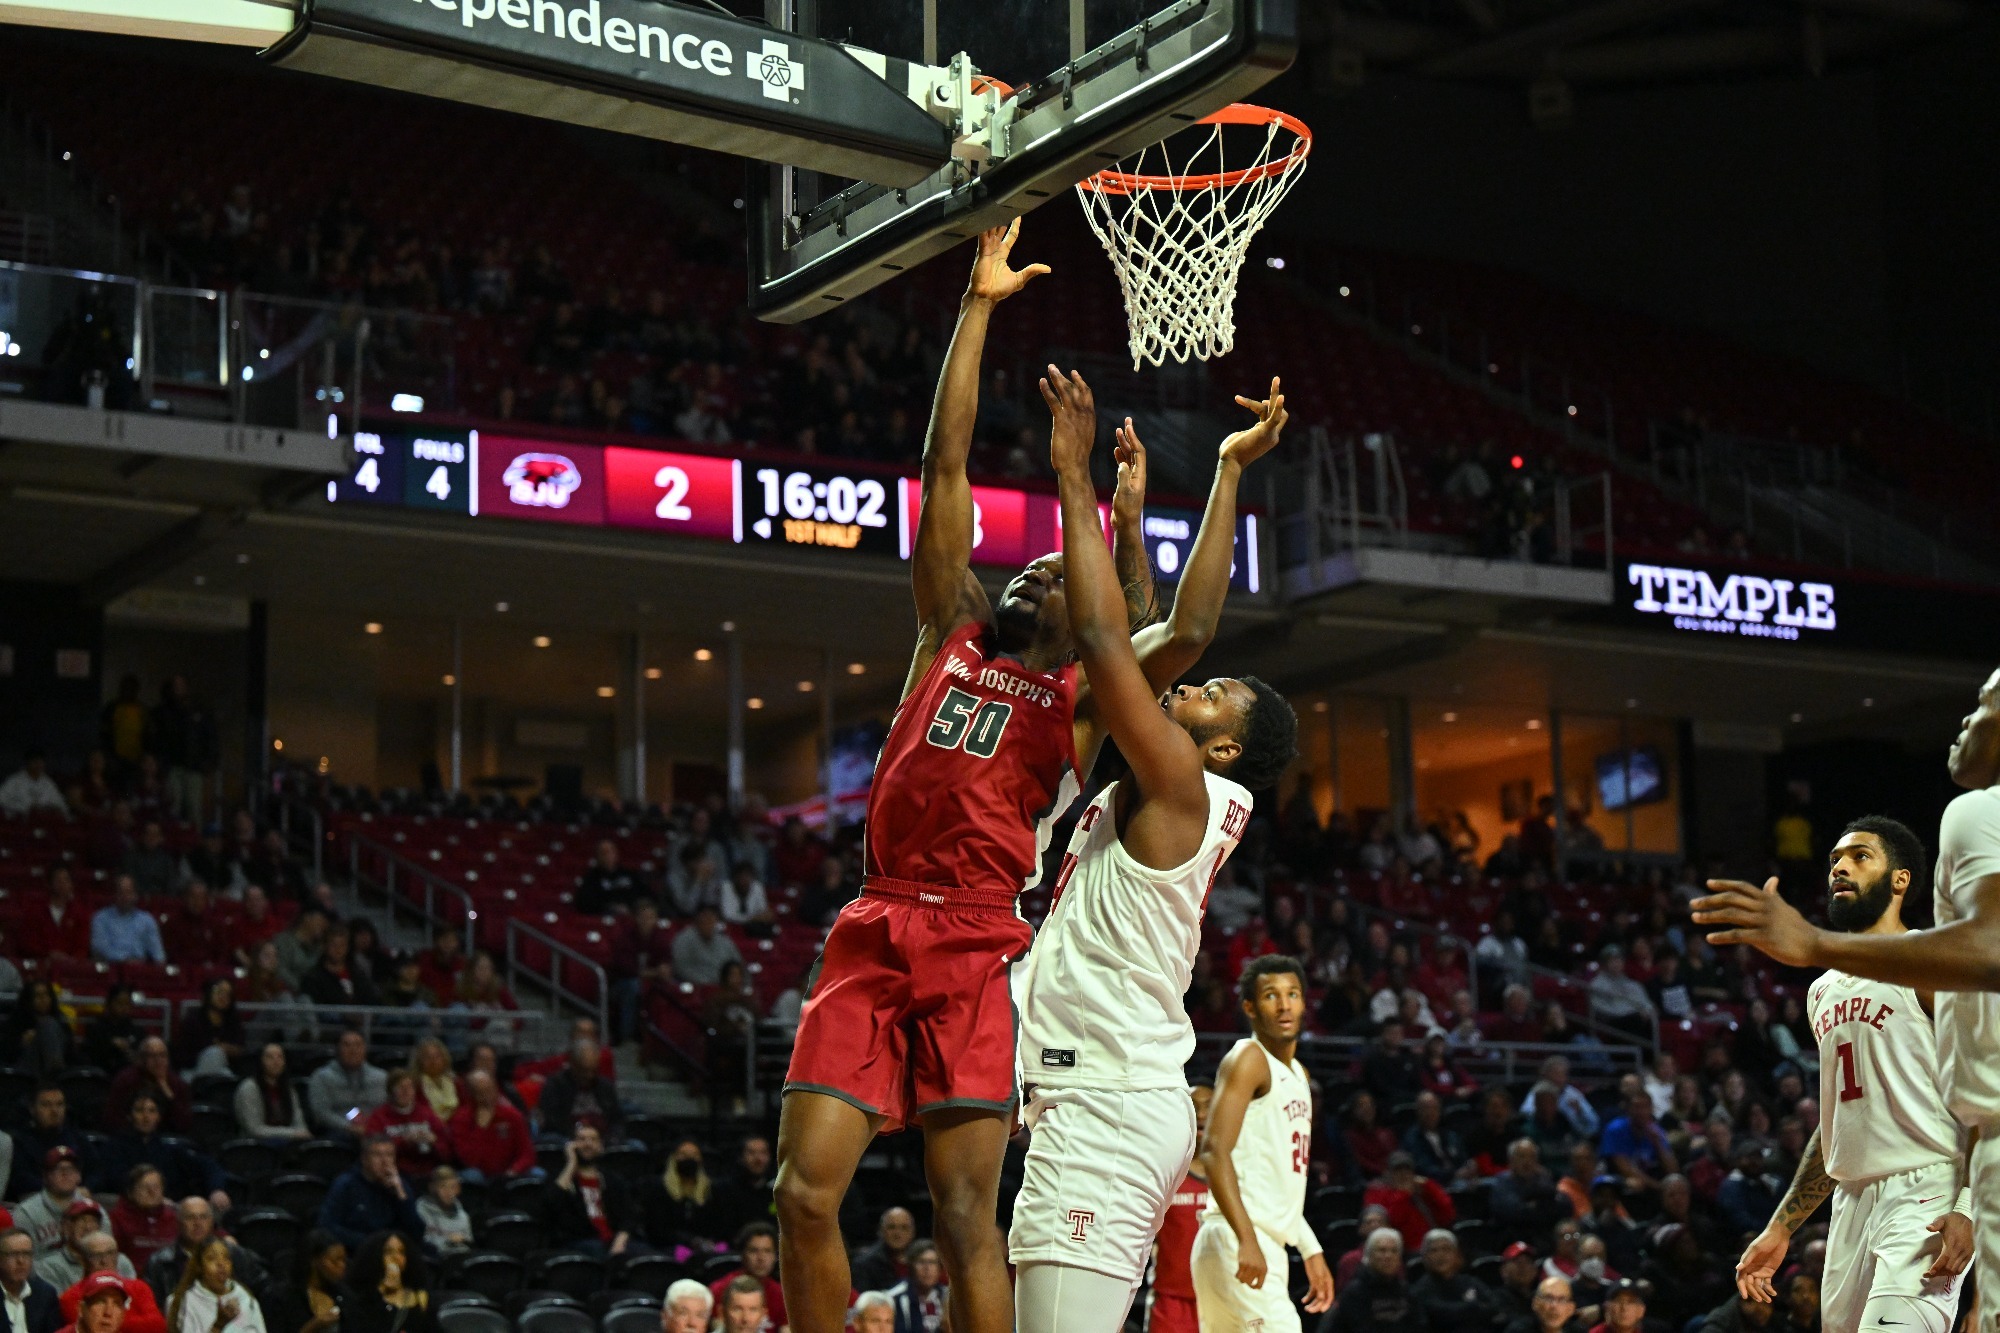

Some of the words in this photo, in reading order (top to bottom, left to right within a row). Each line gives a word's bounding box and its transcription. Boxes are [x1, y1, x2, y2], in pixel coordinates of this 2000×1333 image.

[413, 0, 732, 76] pendence
[355, 458, 380, 493] 4
[426, 465, 451, 500] 4
[654, 466, 692, 521] 2
[757, 469, 887, 527] 16:02
[1157, 541, 1179, 573] 0
[1628, 563, 1836, 630] TEMPLE
[976, 667, 1056, 708] JOSEPH'S
[926, 685, 1013, 759] 50
[1814, 997, 1895, 1042] TEMPLE
[1836, 1041, 1864, 1103] 1
[1067, 1208, 1095, 1244] T
